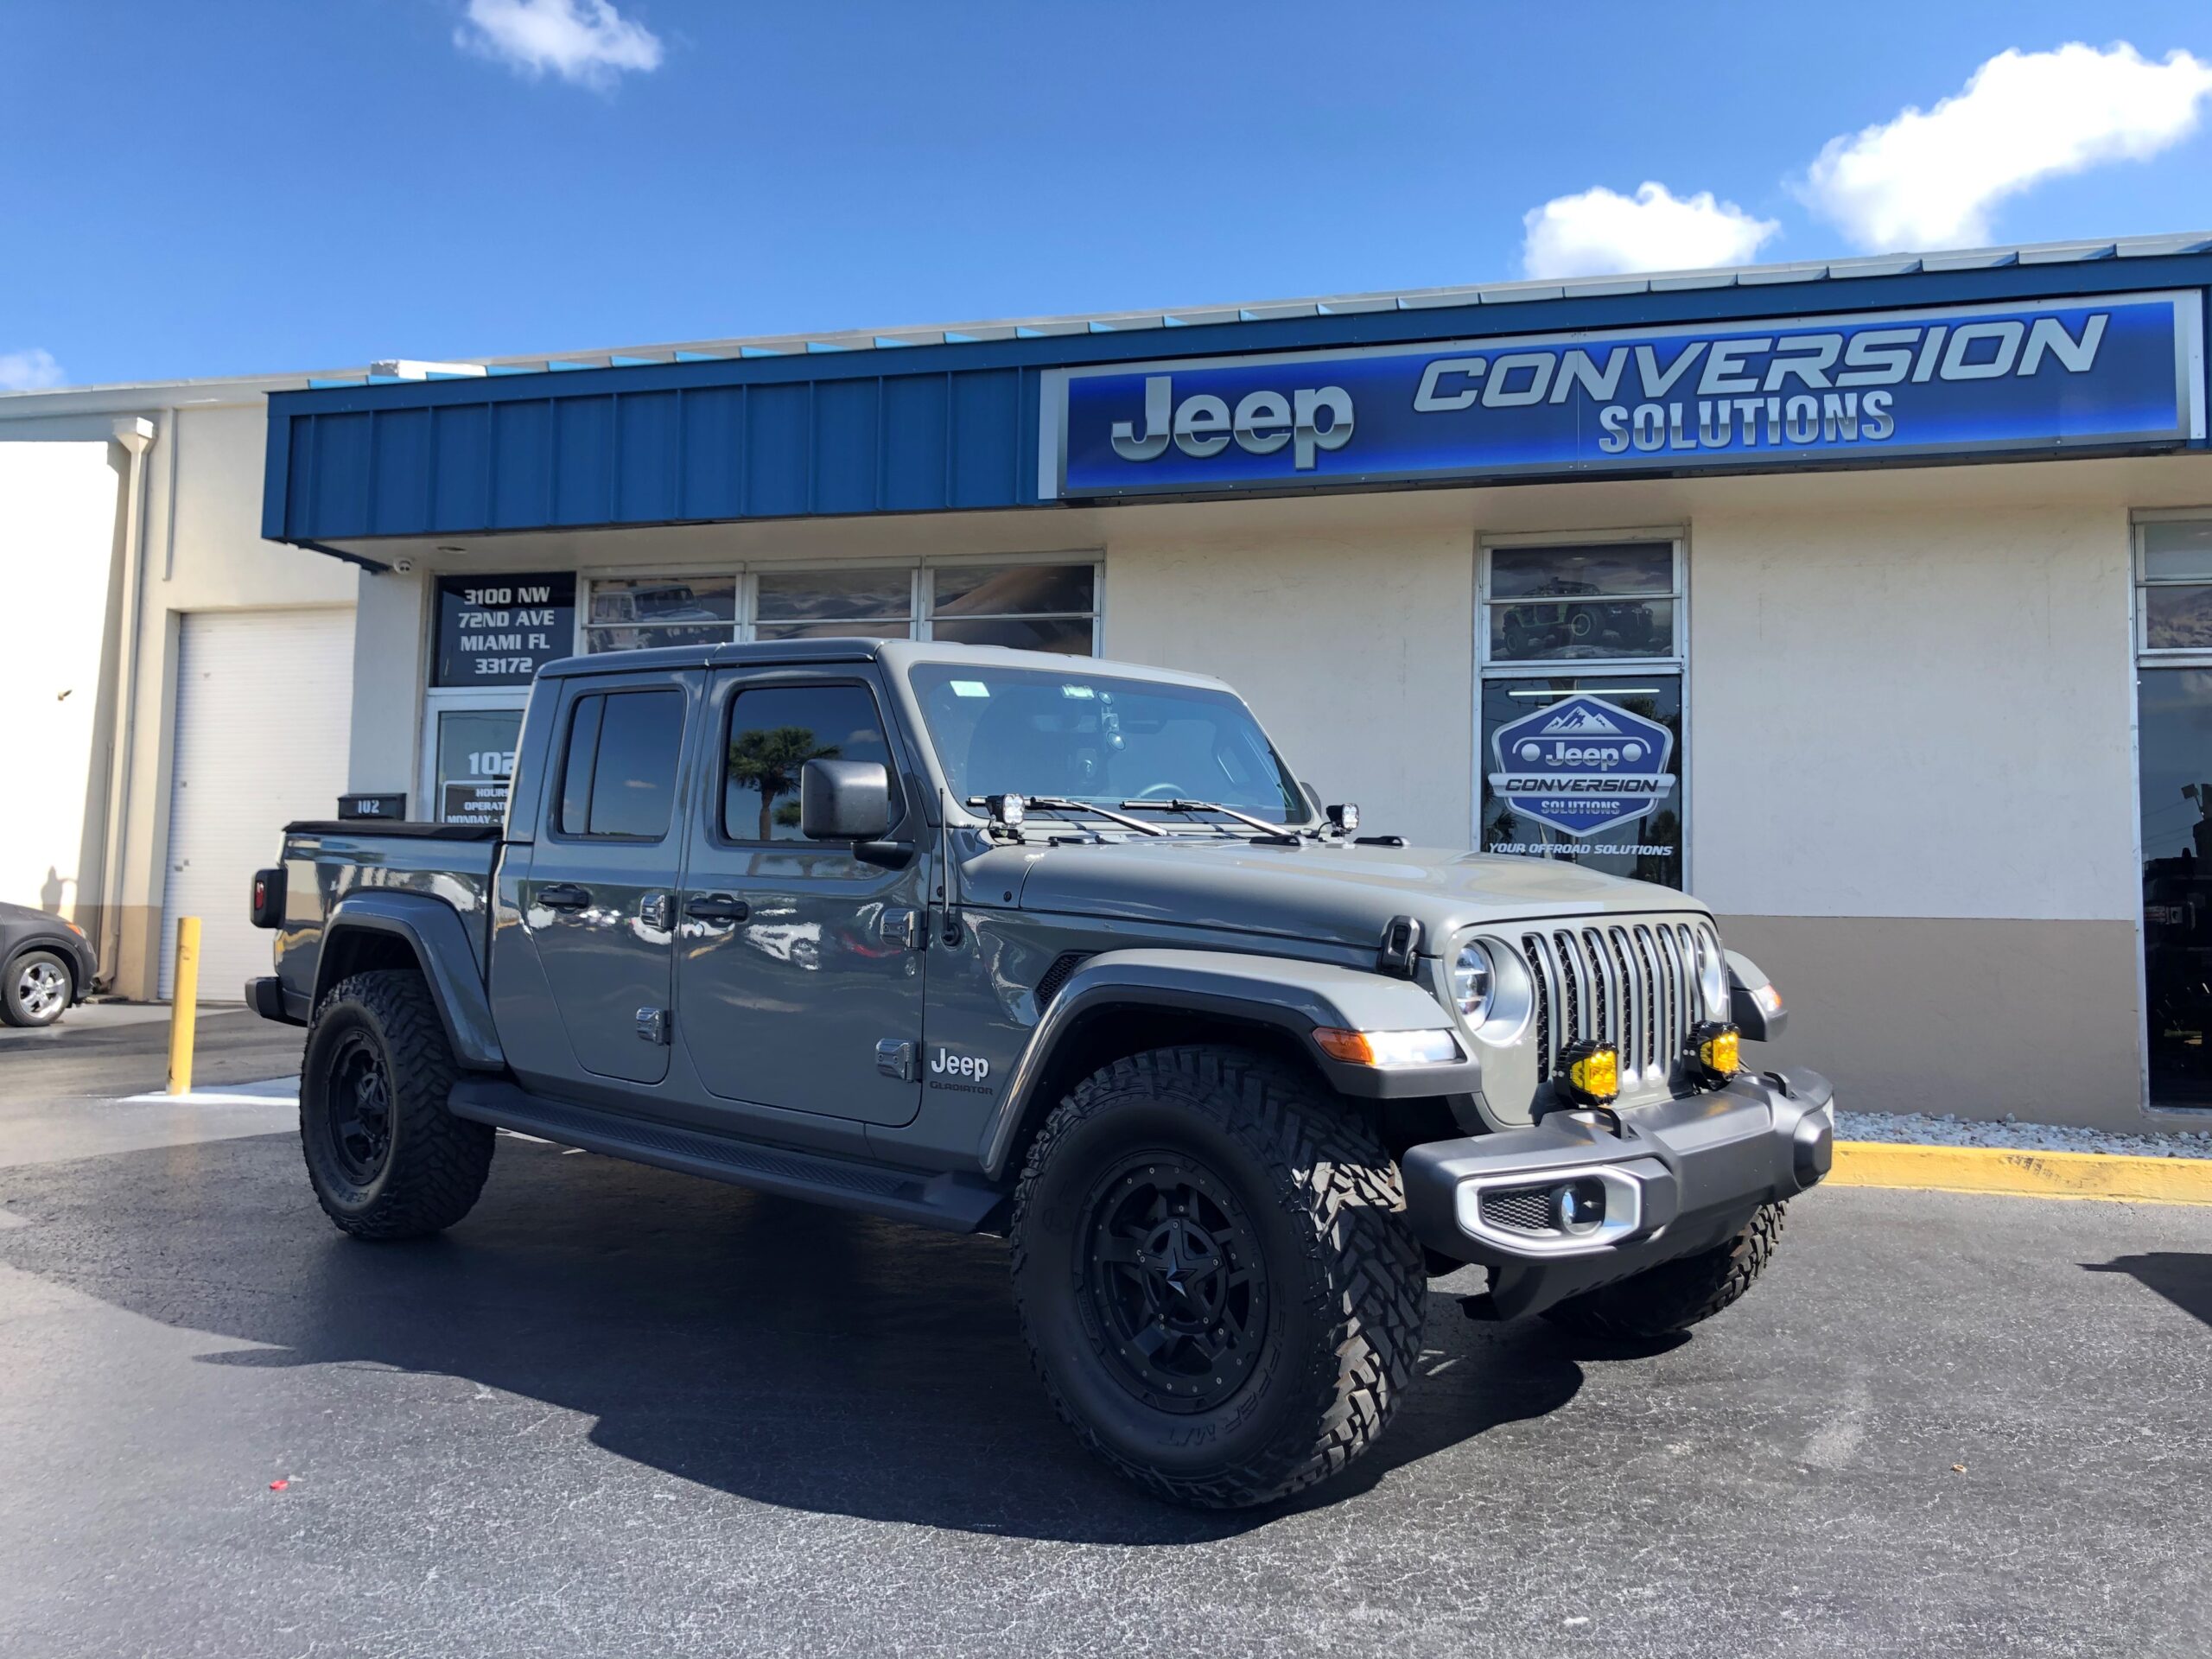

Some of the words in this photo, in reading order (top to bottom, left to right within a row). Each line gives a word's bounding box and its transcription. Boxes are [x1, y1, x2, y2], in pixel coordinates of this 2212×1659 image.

[1413, 313, 2110, 413] CONVERSION
[1110, 375, 1355, 470] Jeep
[1599, 390, 1895, 454] SOLUTIONS
[464, 588, 512, 605] 3100
[518, 587, 550, 602] NW
[458, 612, 509, 628] 72ND
[516, 610, 555, 626] AVE
[461, 634, 521, 652] MIAMI
[529, 633, 550, 649] FL
[475, 658, 532, 674] 33172
[468, 751, 516, 775] 102
[1546, 741, 1619, 771] Jeep
[1505, 779, 1658, 792] CONVERSION
[358, 800, 380, 814] 102
[1541, 800, 1620, 815] SOLUTIONS
[447, 815, 491, 823] MONDAY
[1489, 842, 1526, 854] YOUR
[1529, 843, 1591, 855] OFFROAD
[1593, 844, 1673, 856] SOLUTIONS
[931, 1048, 989, 1083] Jeep
[930, 1080, 994, 1096] GLADIATOR
